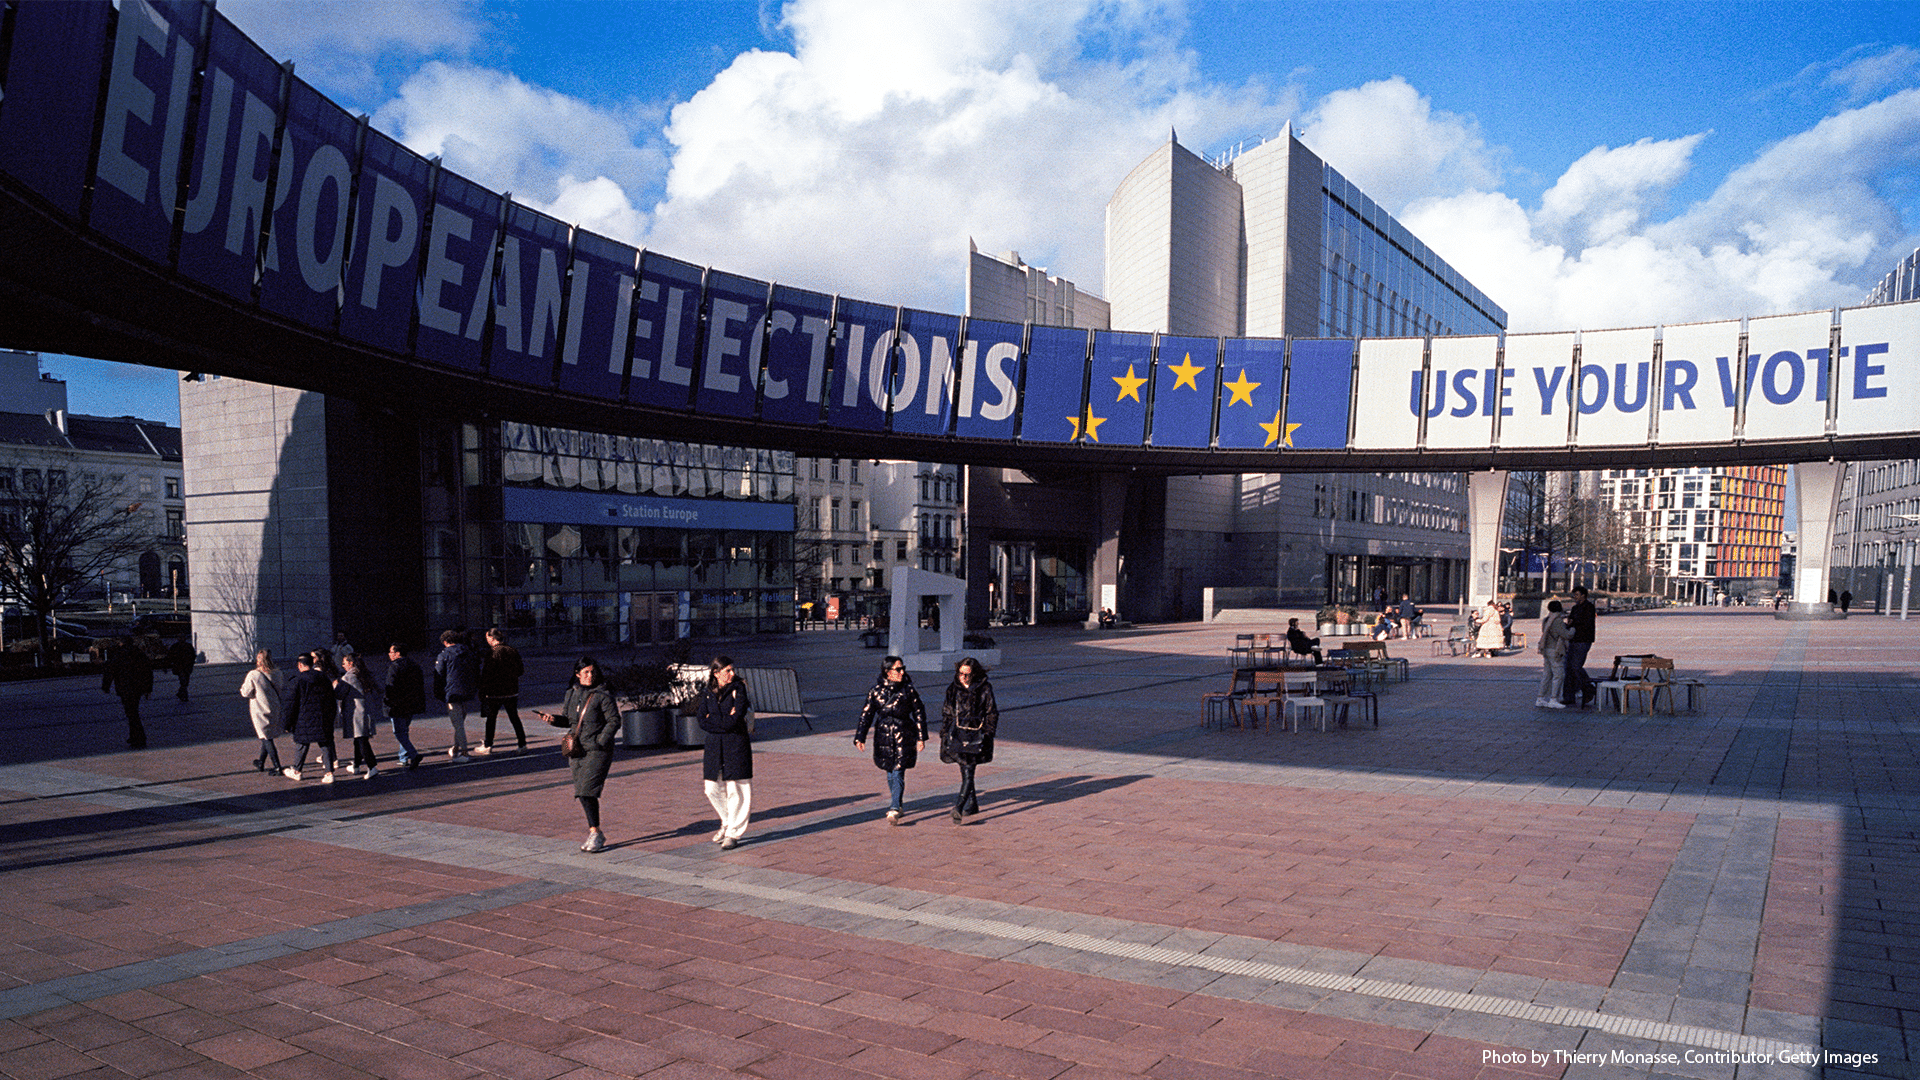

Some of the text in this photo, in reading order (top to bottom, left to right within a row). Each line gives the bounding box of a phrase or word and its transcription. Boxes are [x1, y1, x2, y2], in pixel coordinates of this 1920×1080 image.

[97, 0, 1020, 421] EUROPEAN ELECTIONS
[1409, 342, 1889, 418] USE YOUR VOTE
[622, 503, 699, 523] Station Europe
